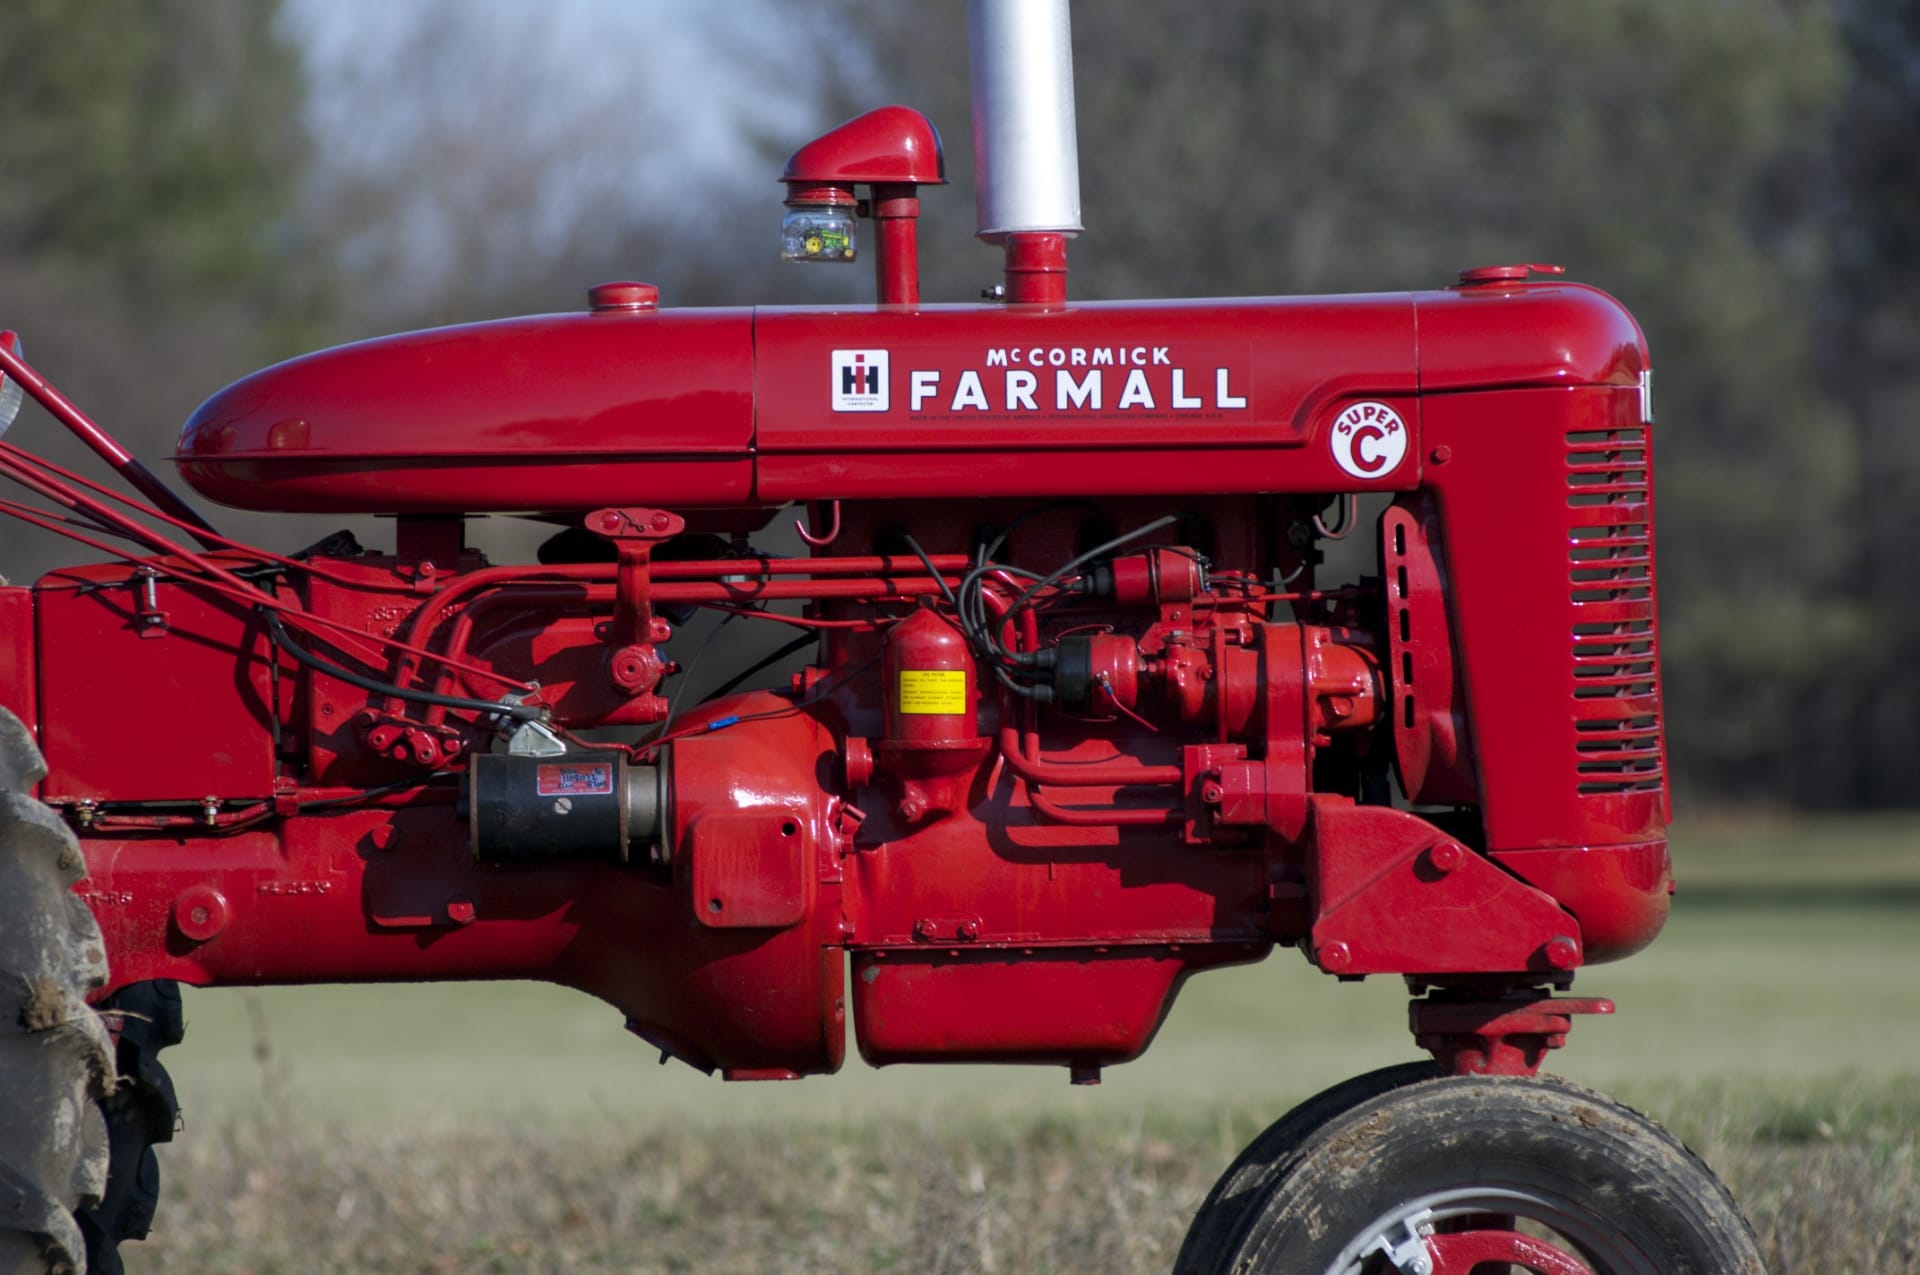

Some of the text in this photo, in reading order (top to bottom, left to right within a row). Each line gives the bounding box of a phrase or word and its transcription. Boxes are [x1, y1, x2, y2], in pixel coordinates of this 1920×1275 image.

[910, 368, 1247, 411] FARMALL
[1338, 406, 1400, 436] SUPER
[1350, 425, 1387, 472] C
